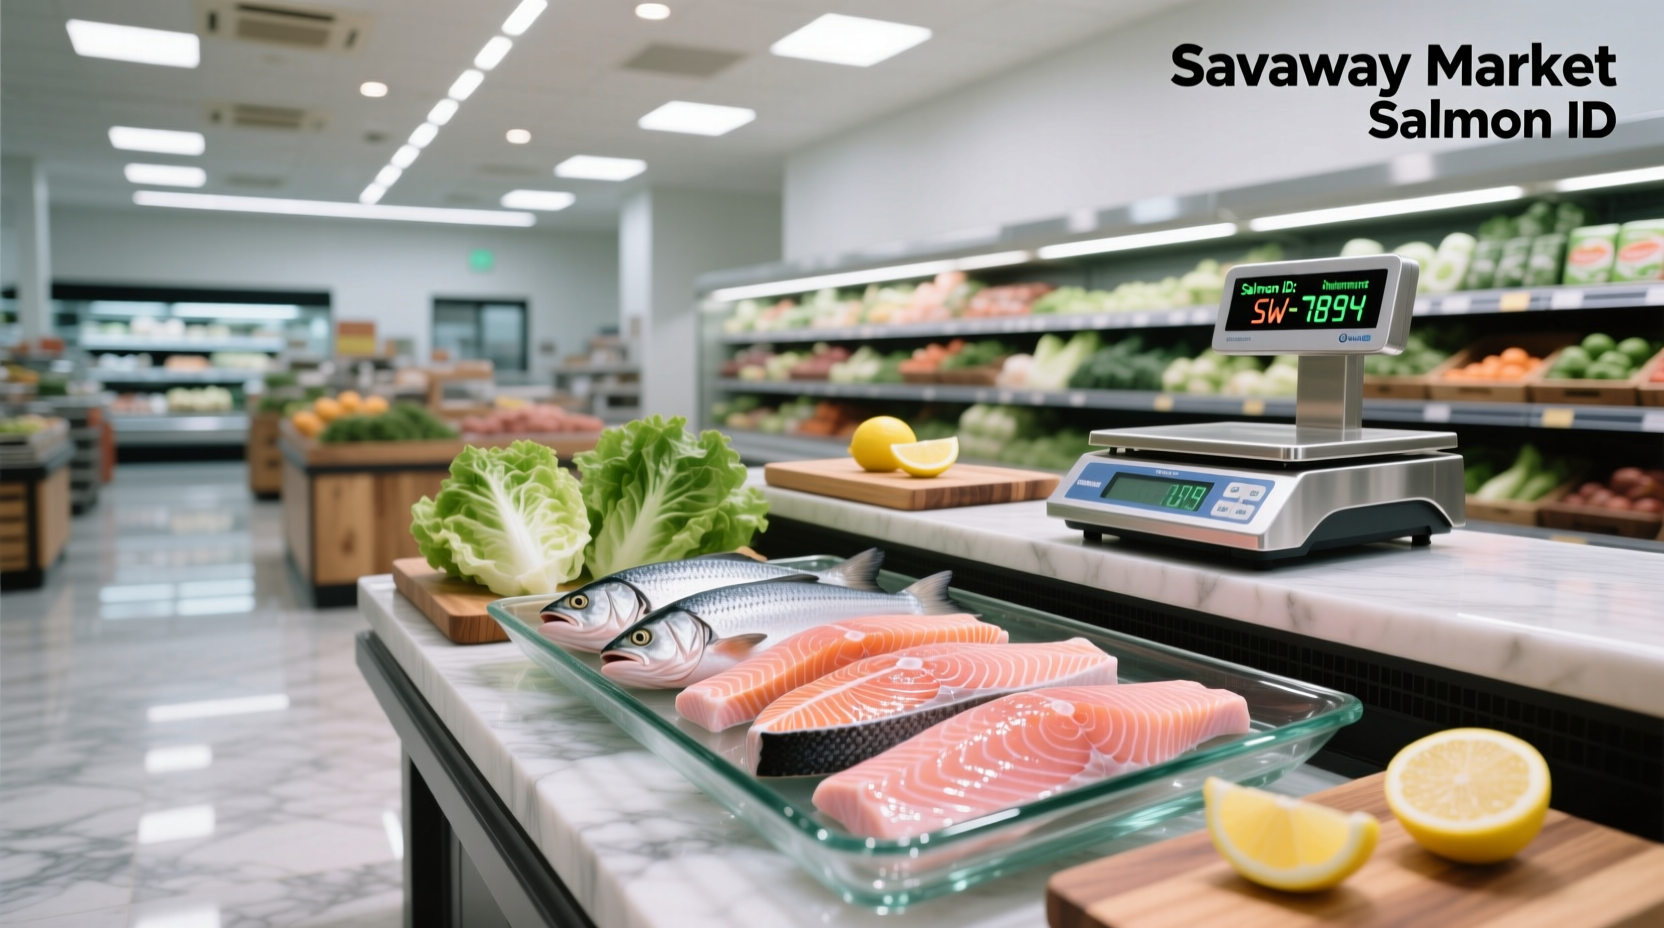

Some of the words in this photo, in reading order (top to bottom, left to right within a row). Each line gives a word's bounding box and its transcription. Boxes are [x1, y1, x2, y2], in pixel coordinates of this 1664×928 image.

[1240, 282, 1279, 296] Salmon
[1282, 280, 1296, 294] ID:
[1250, 294, 1367, 324] SW-7894
